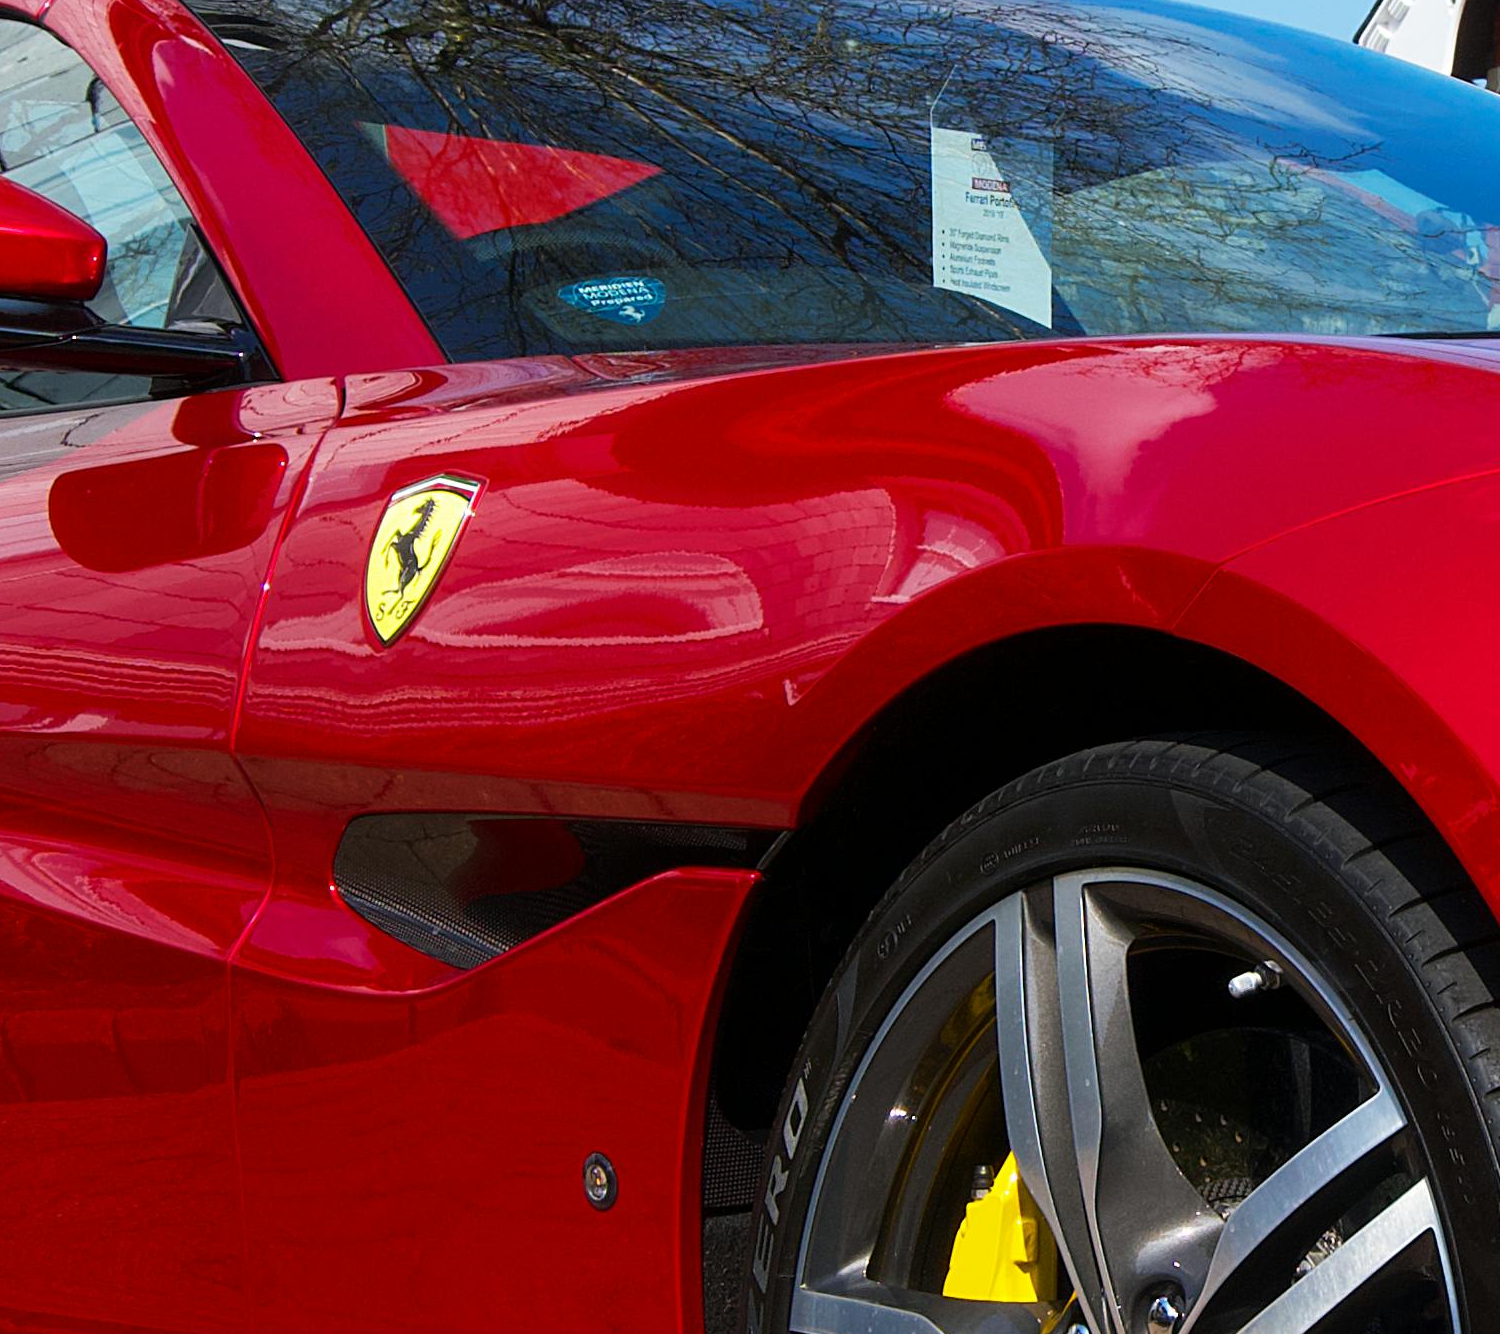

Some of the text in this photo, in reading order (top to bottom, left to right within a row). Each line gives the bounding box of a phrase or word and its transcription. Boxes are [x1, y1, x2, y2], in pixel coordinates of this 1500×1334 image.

[579, 280, 644, 294] MERIDIEN
[583, 287, 650, 299] MODENA
[591, 294, 653, 306] Prepared
